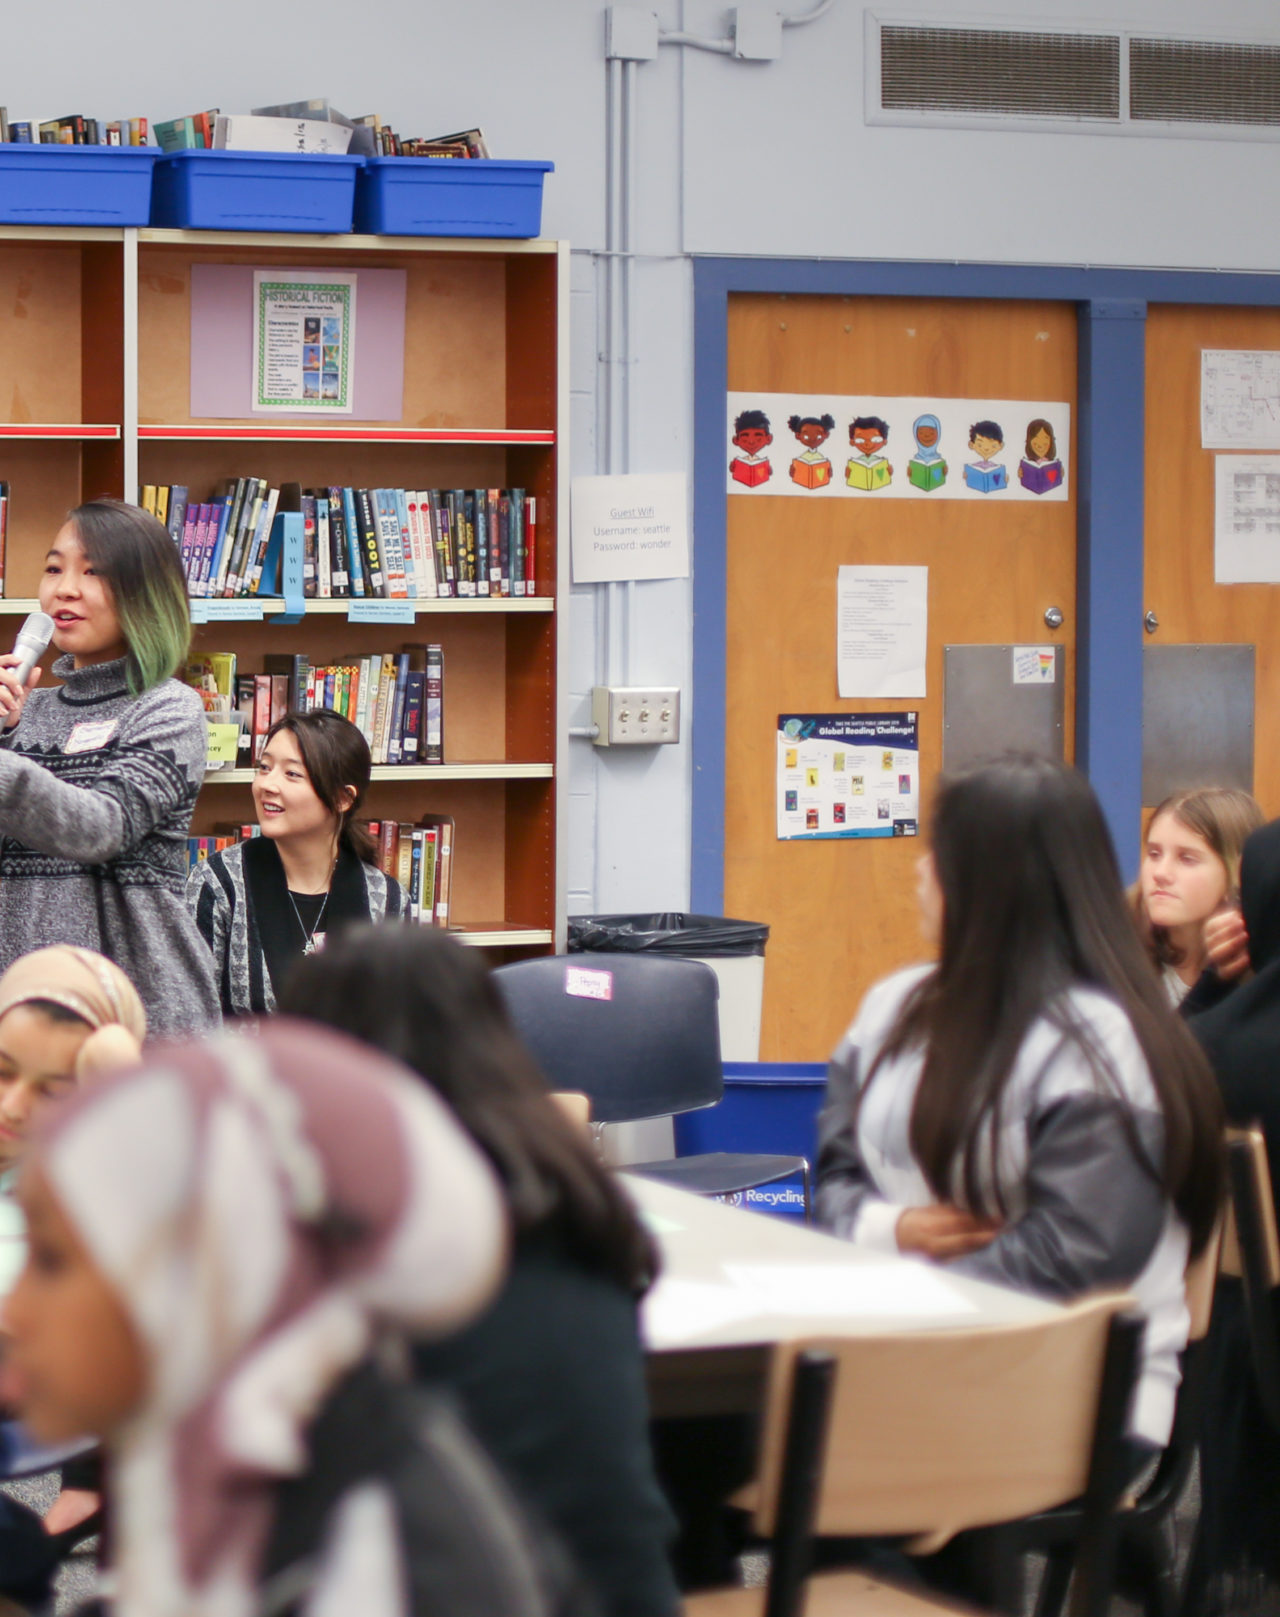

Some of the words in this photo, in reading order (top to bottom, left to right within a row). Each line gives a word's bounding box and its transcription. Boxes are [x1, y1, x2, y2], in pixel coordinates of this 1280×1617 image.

[265, 291, 311, 302] HISTORICAL
[312, 292, 344, 304] FICTION
[362, 494, 371, 526] WATSON
[609, 507, 636, 518] Guest
[381, 521, 390, 536] SAVE
[390, 521, 399, 536] SAVE
[384, 538, 391, 547] ME
[392, 538, 400, 547] ME
[593, 540, 637, 552] Password:
[640, 539, 672, 549] wonder
[366, 531, 379, 569] LOOT
[387, 556, 395, 570] SEAT
[395, 556, 403, 570] SEAT
[819, 727, 844, 735] Global
[845, 726, 875, 736] Reading
